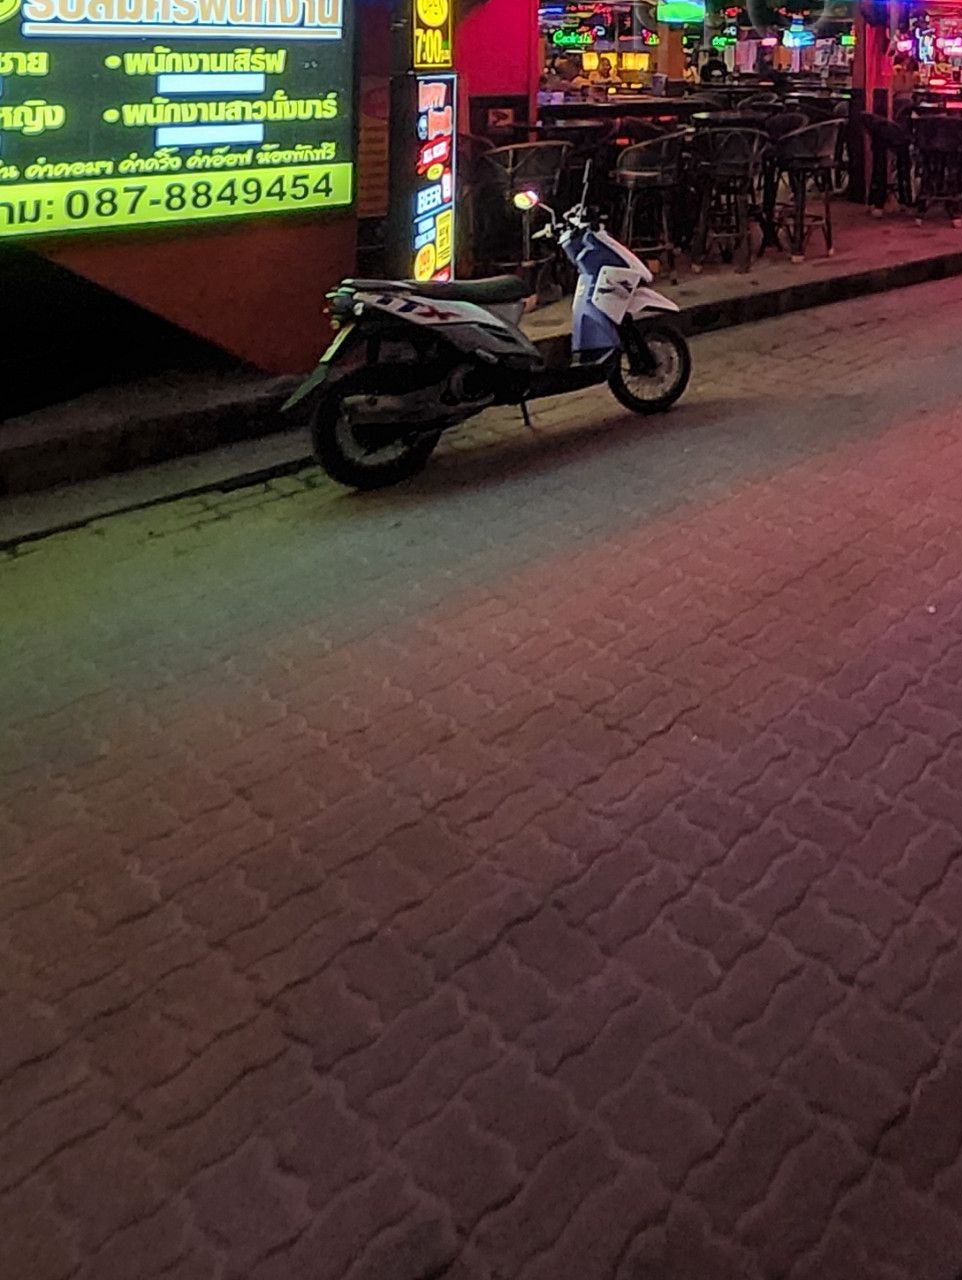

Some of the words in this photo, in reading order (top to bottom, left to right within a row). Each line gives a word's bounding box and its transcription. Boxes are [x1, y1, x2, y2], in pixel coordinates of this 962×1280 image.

[124, 46, 286, 75] พนักงานเสิร์ฟ
[415, 28, 442, 63] 7:00
[66, 173, 333, 220] 087-8849454
